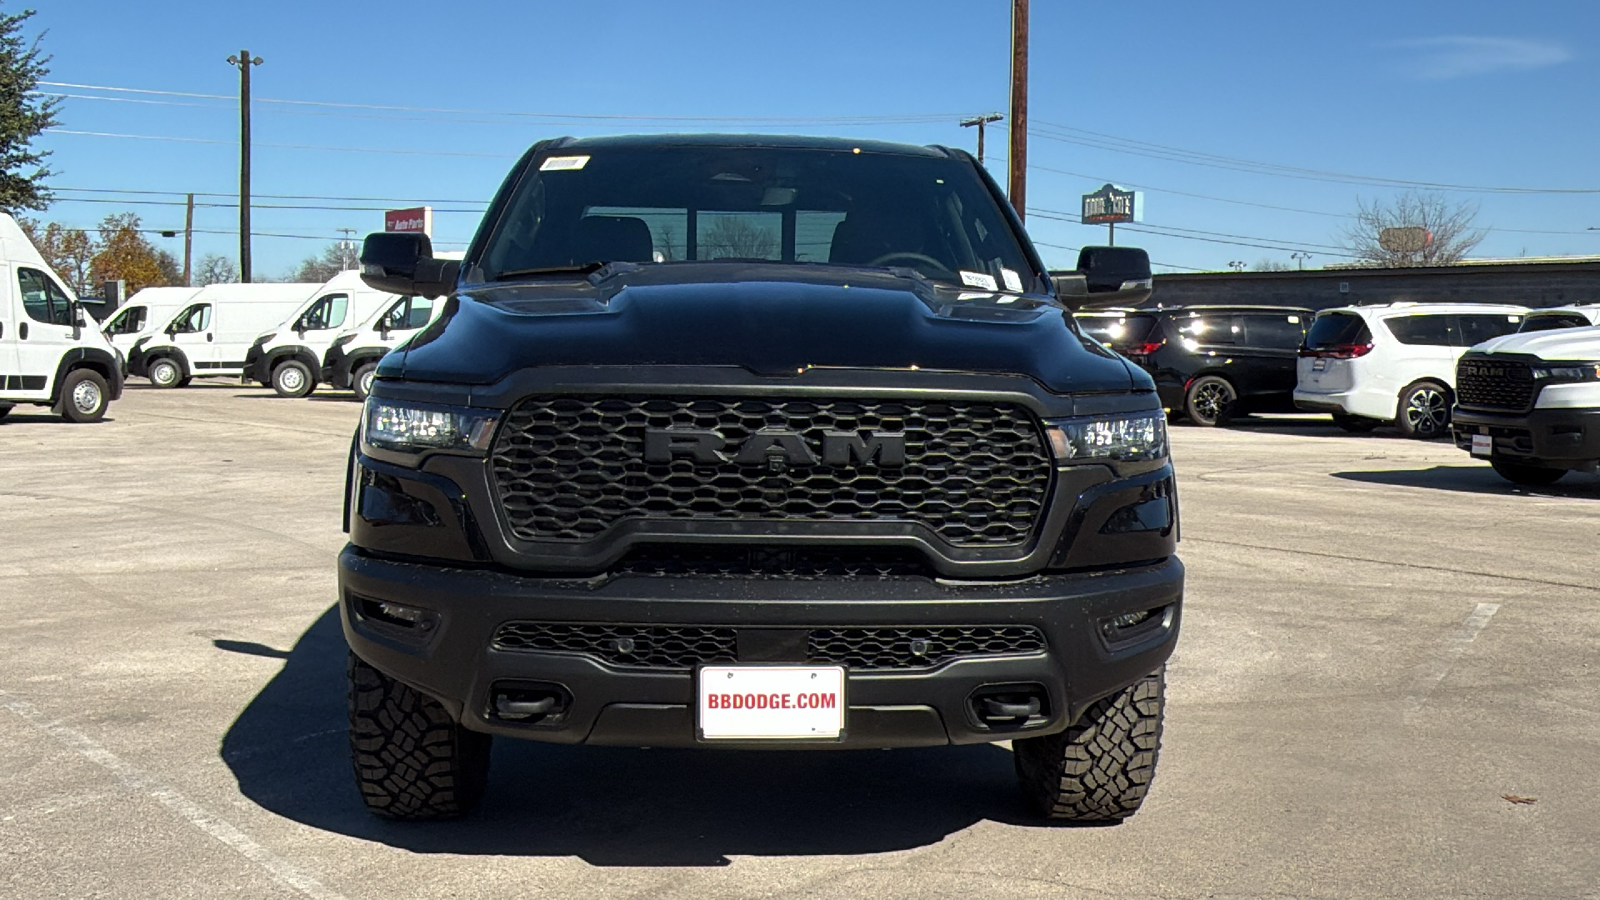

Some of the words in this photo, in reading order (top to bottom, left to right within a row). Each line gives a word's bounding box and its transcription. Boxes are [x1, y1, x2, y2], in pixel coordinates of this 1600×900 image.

[394, 219, 408, 230] Auto
[408, 218, 424, 229] Parts
[1467, 366, 1504, 376] RAM
[644, 428, 906, 466] RAM
[708, 693, 836, 709] BBDODGE.COM
